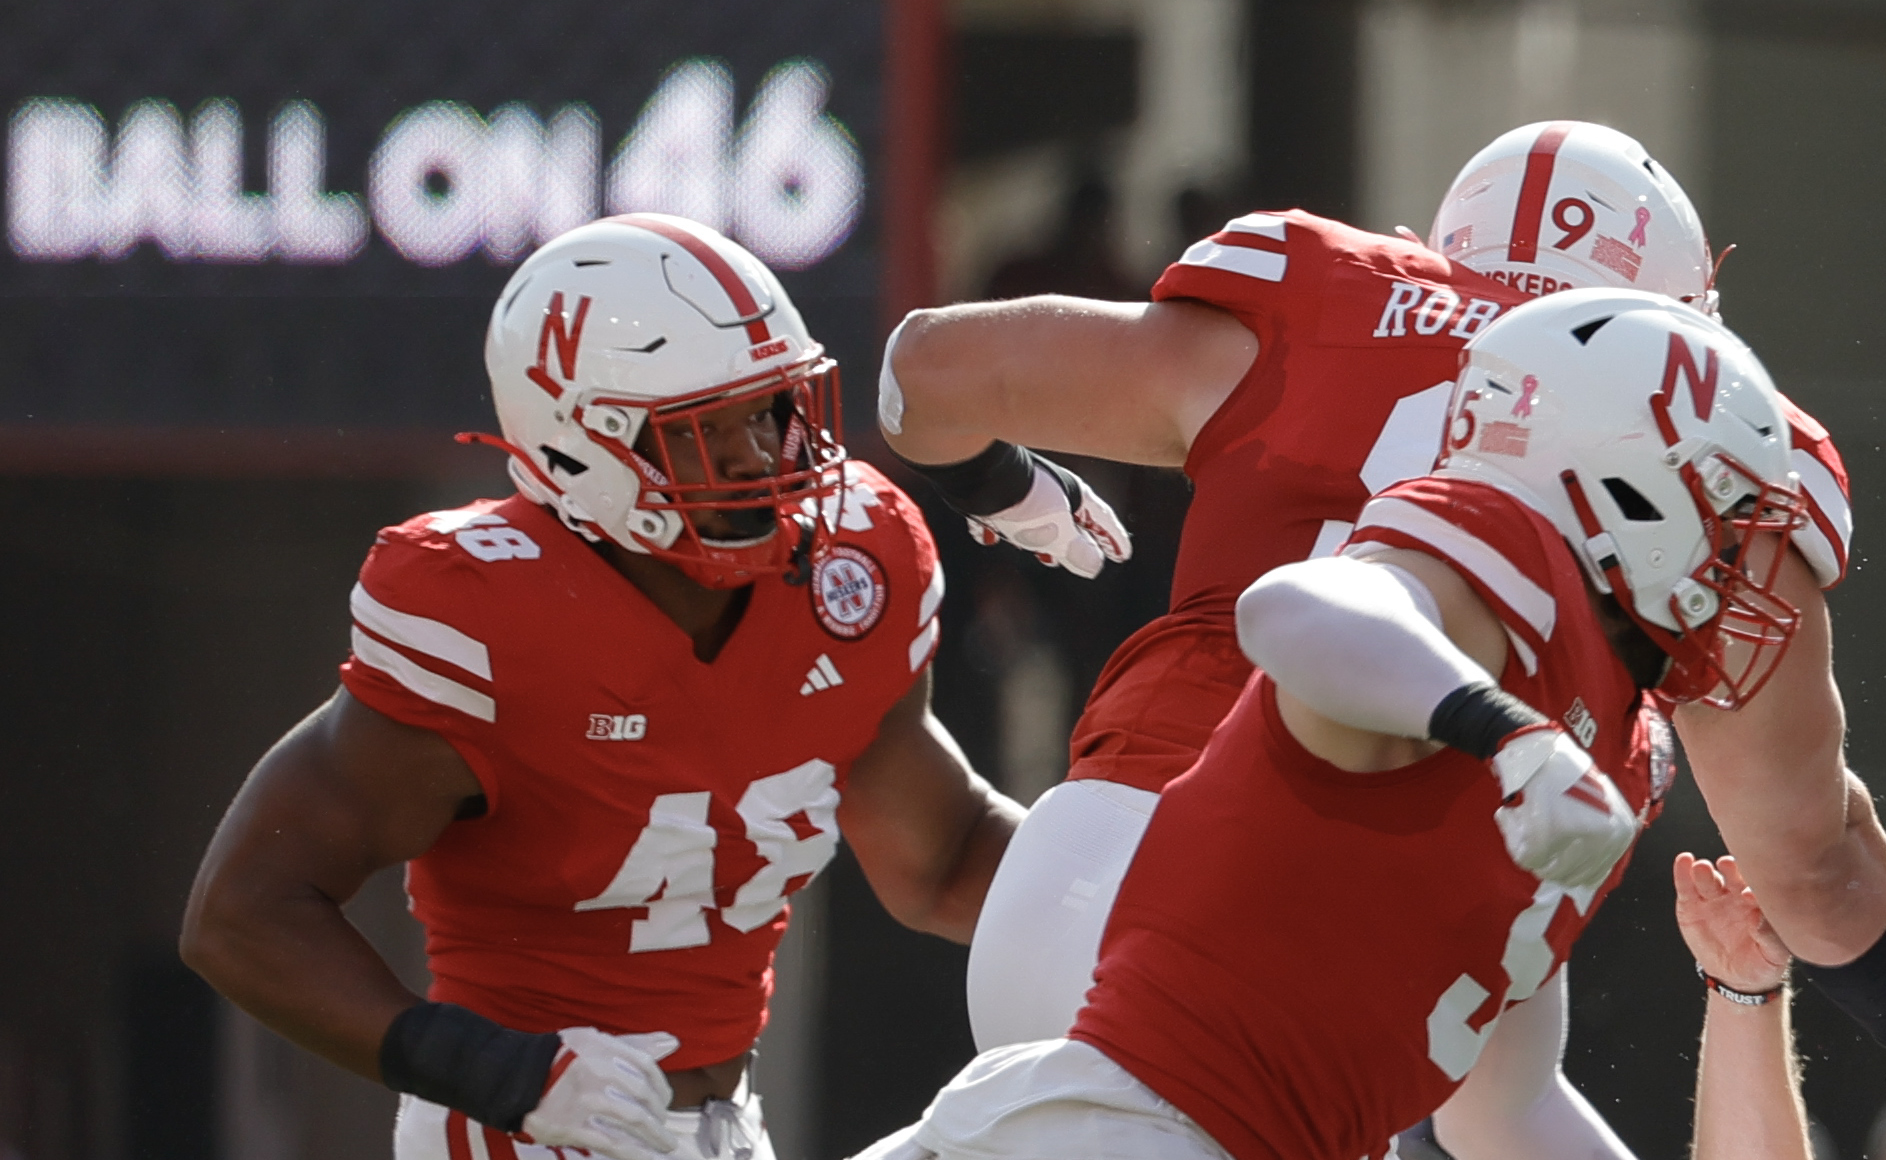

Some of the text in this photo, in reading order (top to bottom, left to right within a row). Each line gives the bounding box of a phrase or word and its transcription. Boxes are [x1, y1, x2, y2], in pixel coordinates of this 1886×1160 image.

[8, 55, 865, 270] BALL ON 46
[1552, 197, 1595, 251] 9
[526, 290, 592, 400] N
[574, 758, 840, 953] 48
[1718, 985, 1764, 1006] TRUST
